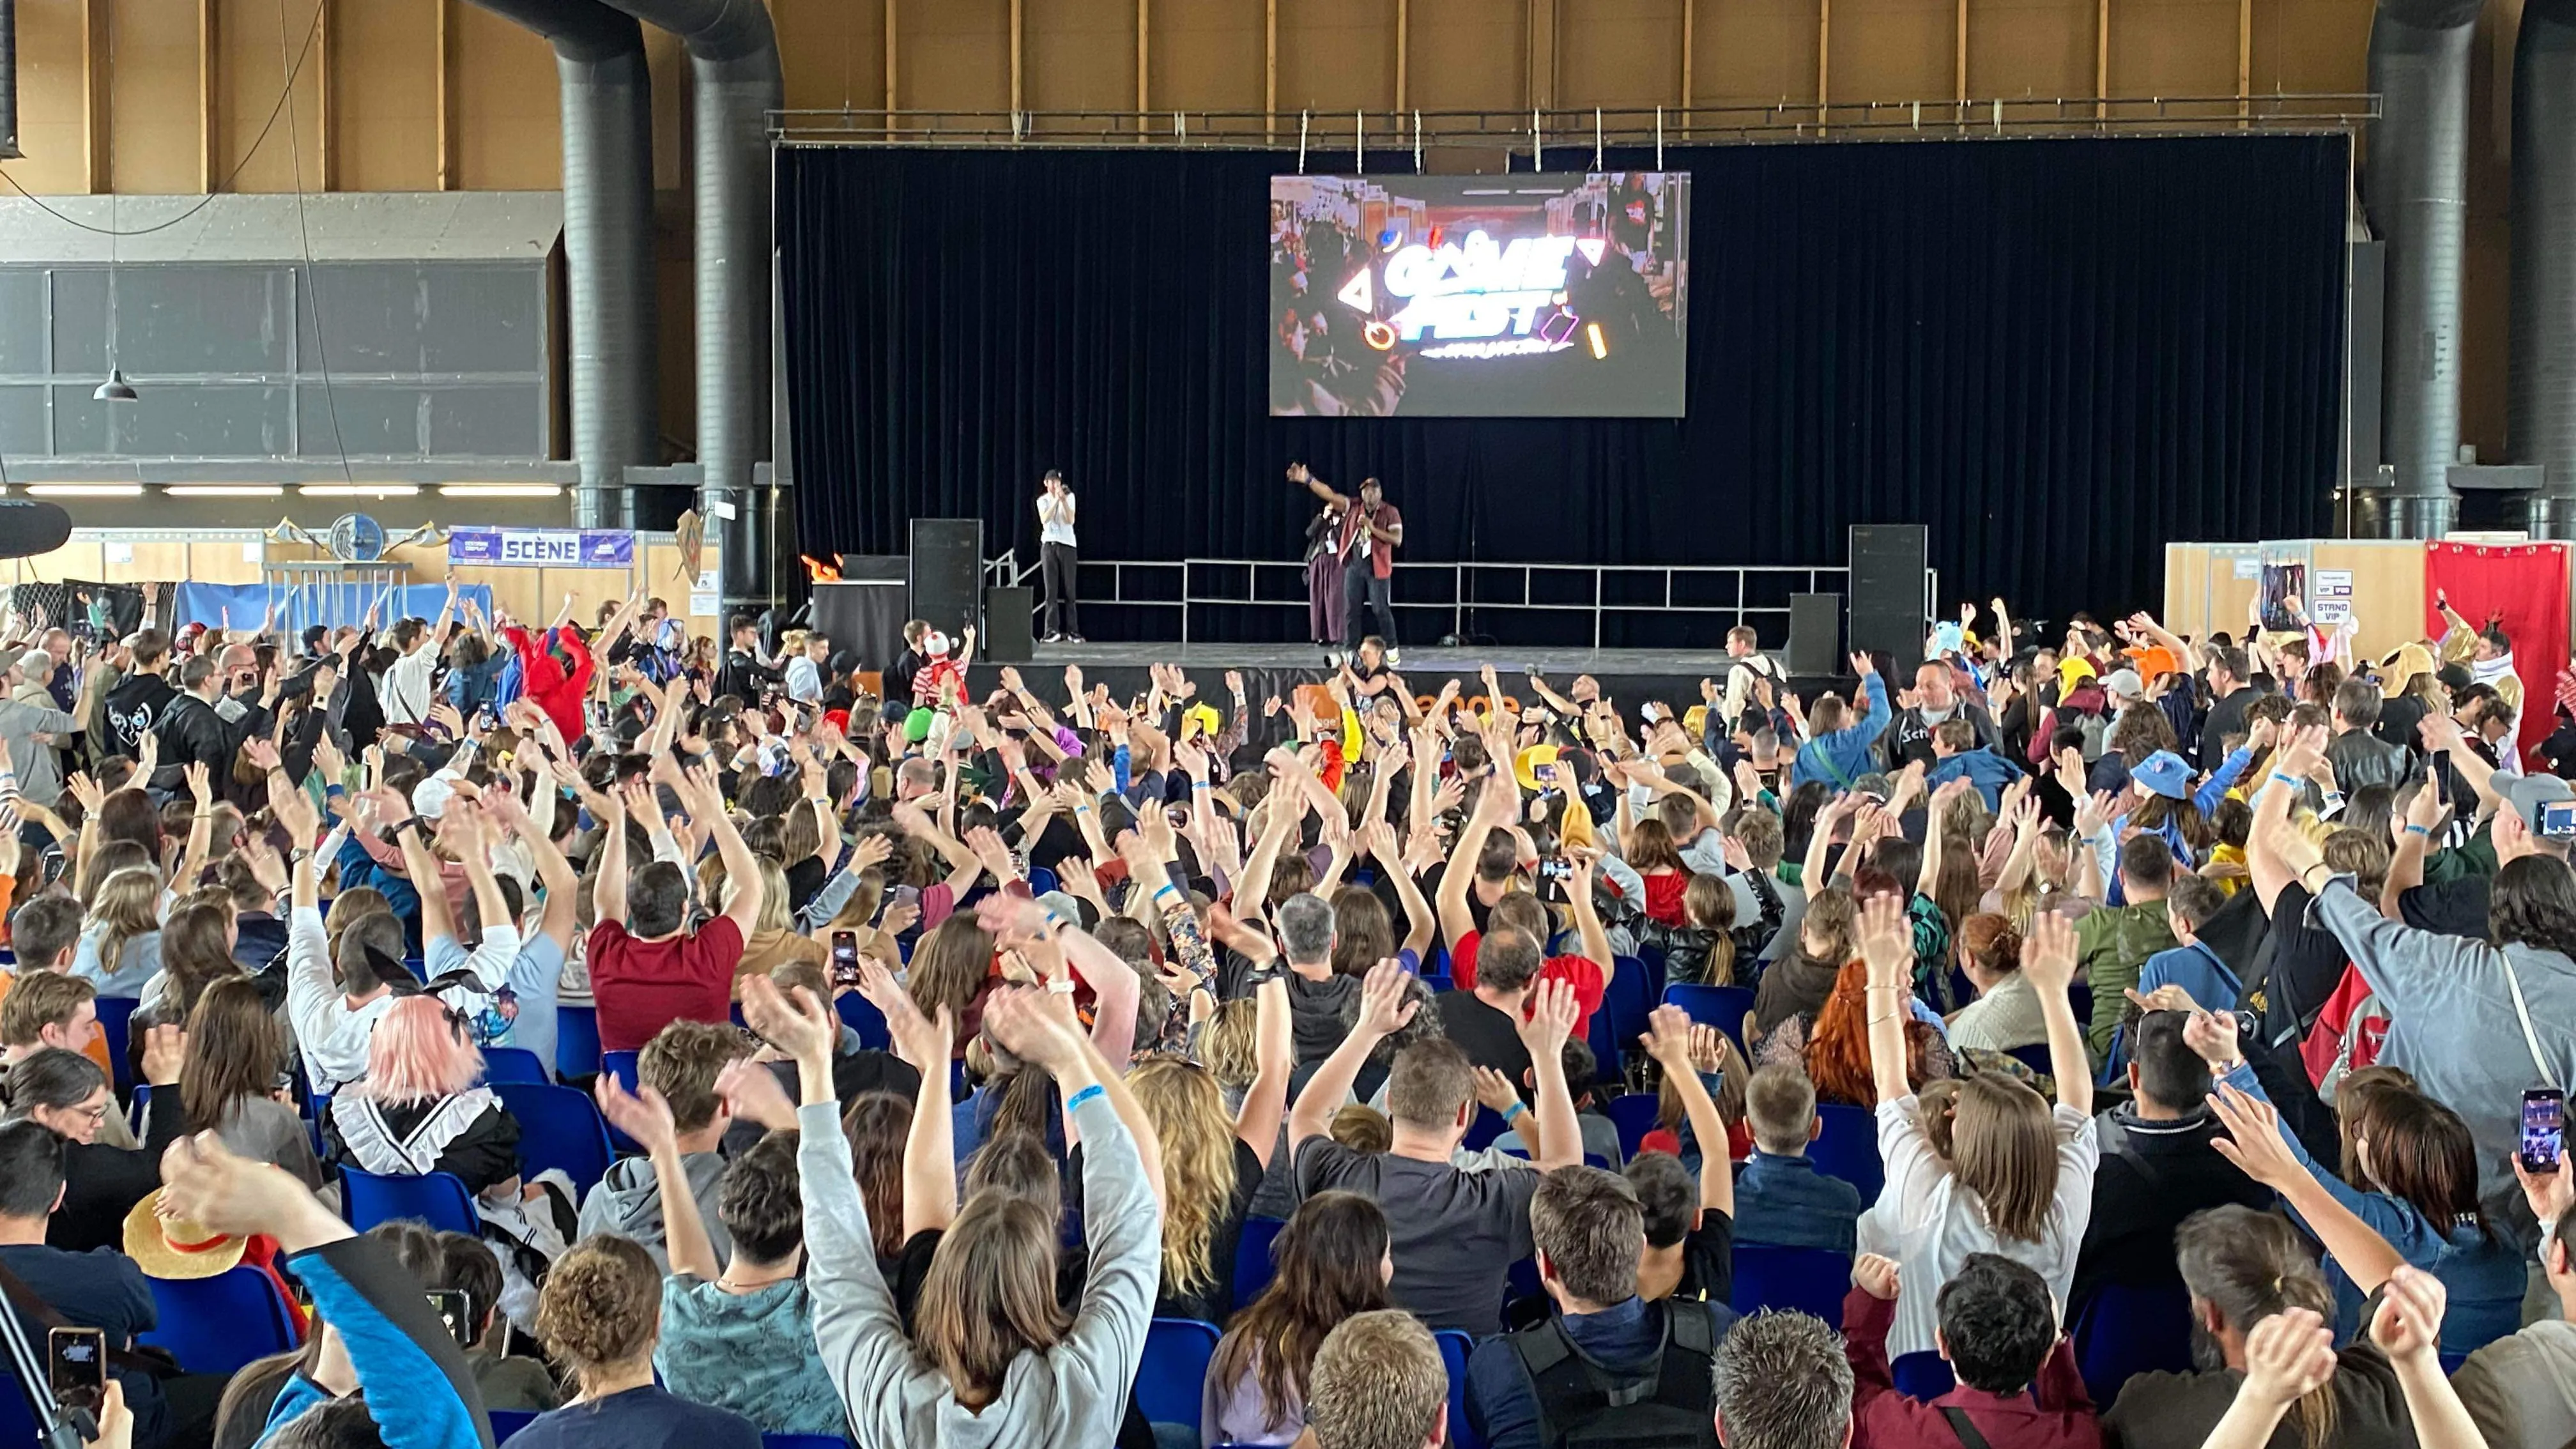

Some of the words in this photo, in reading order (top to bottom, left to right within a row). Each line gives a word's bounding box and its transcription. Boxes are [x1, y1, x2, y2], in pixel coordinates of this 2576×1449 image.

[506, 536, 576, 559] SCÈNE
[1414, 695, 1520, 721] ange
[1902, 728, 1929, 742] Sch
